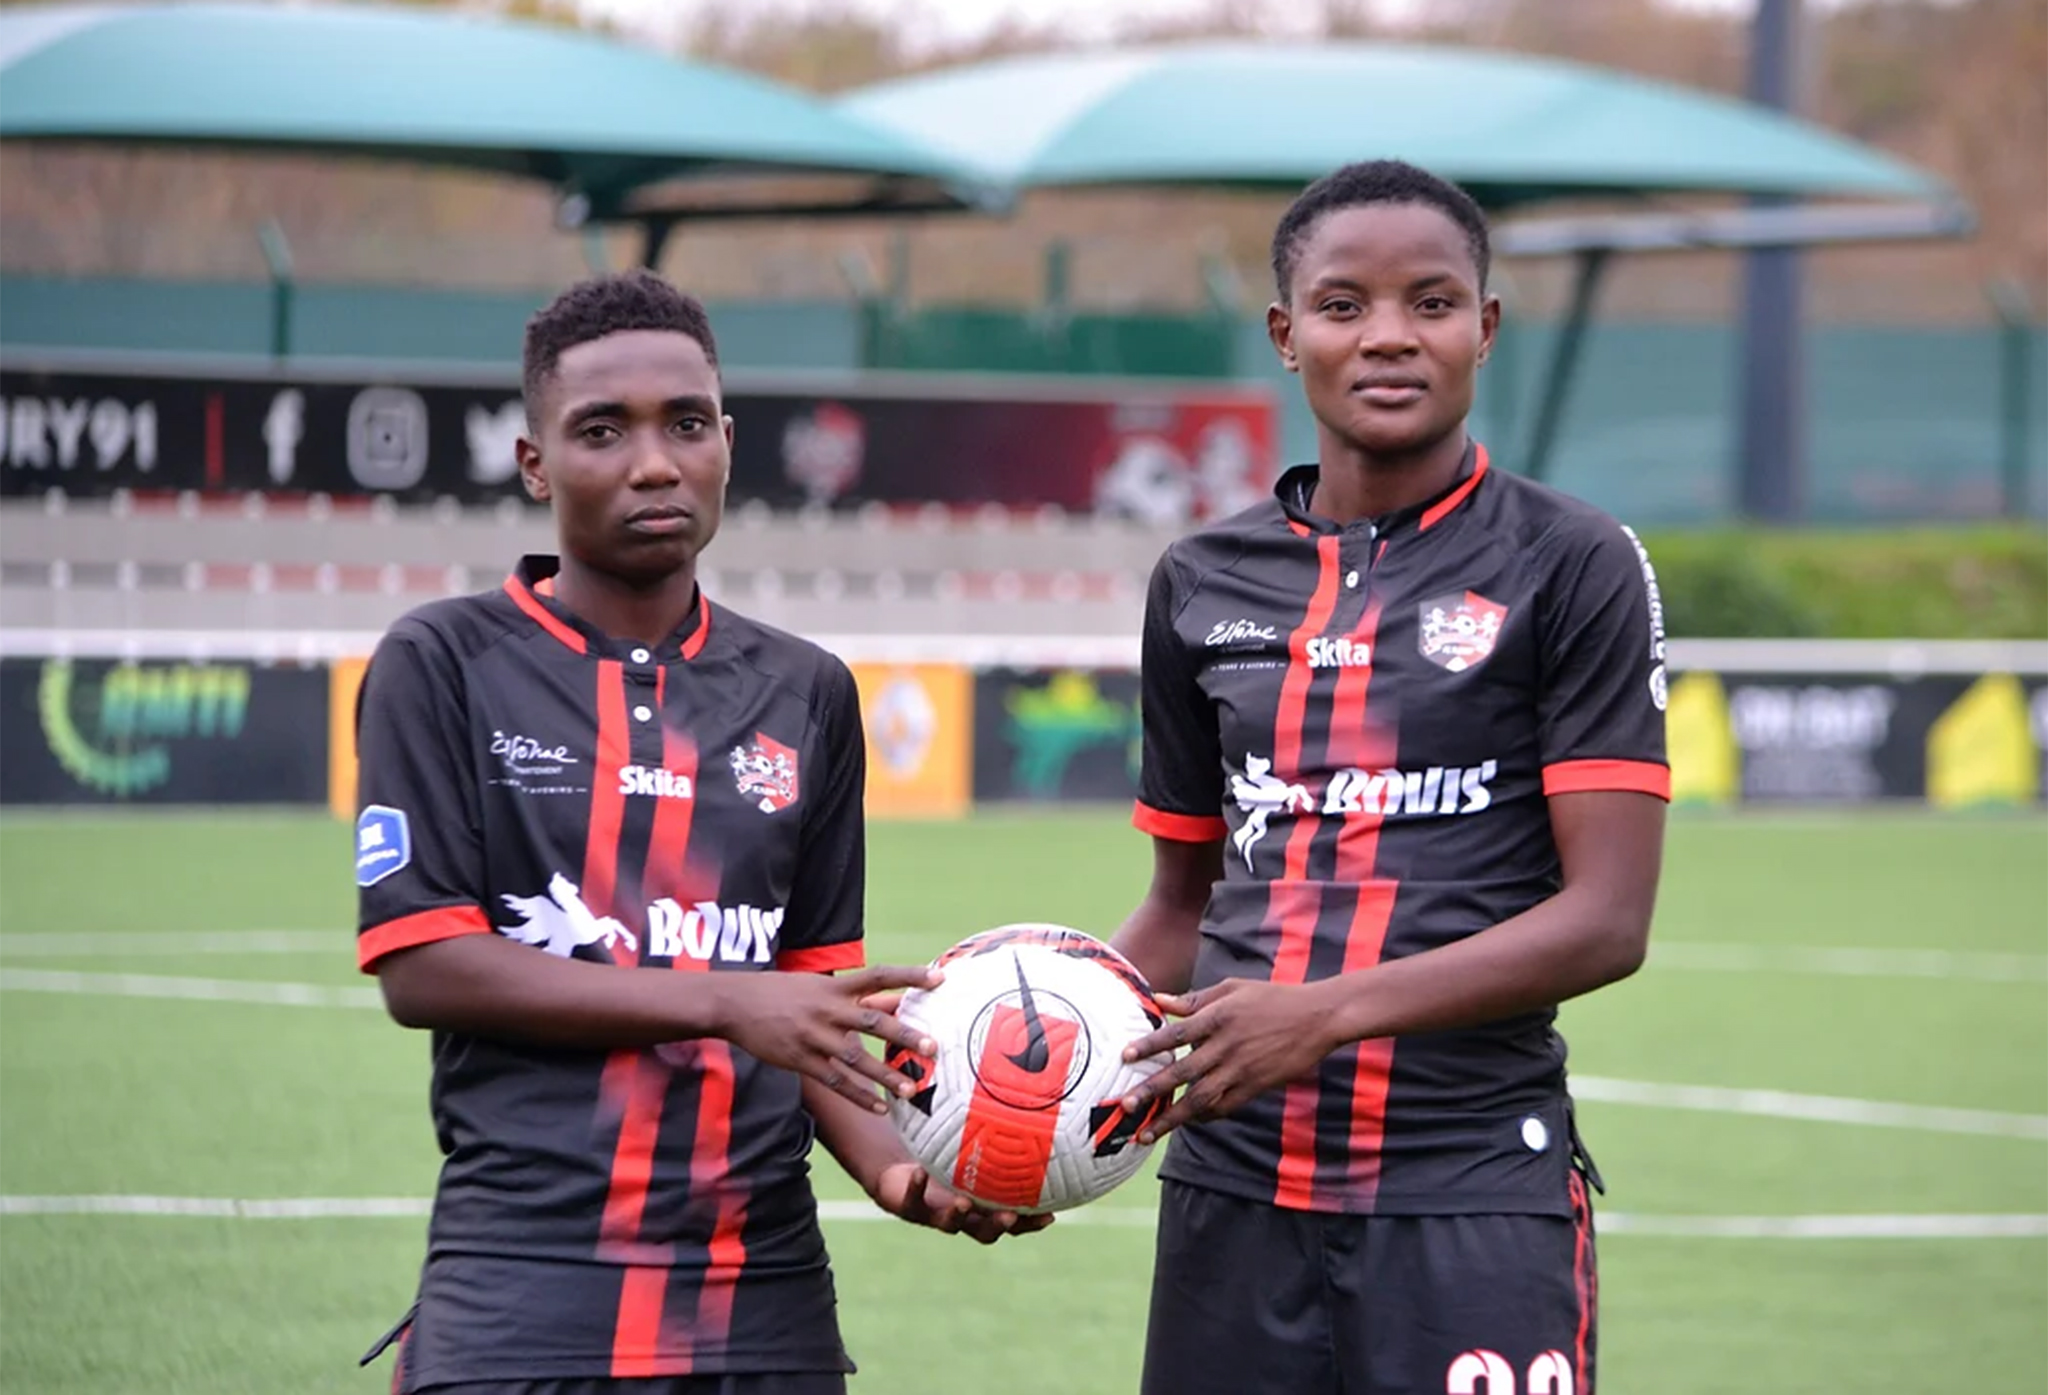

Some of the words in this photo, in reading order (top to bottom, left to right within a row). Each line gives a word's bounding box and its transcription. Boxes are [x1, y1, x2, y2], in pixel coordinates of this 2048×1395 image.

[0, 396, 158, 472] RY91
[1306, 636, 1371, 668] Skita
[618, 764, 693, 799] Skita
[1321, 758, 1498, 815] BOVIS
